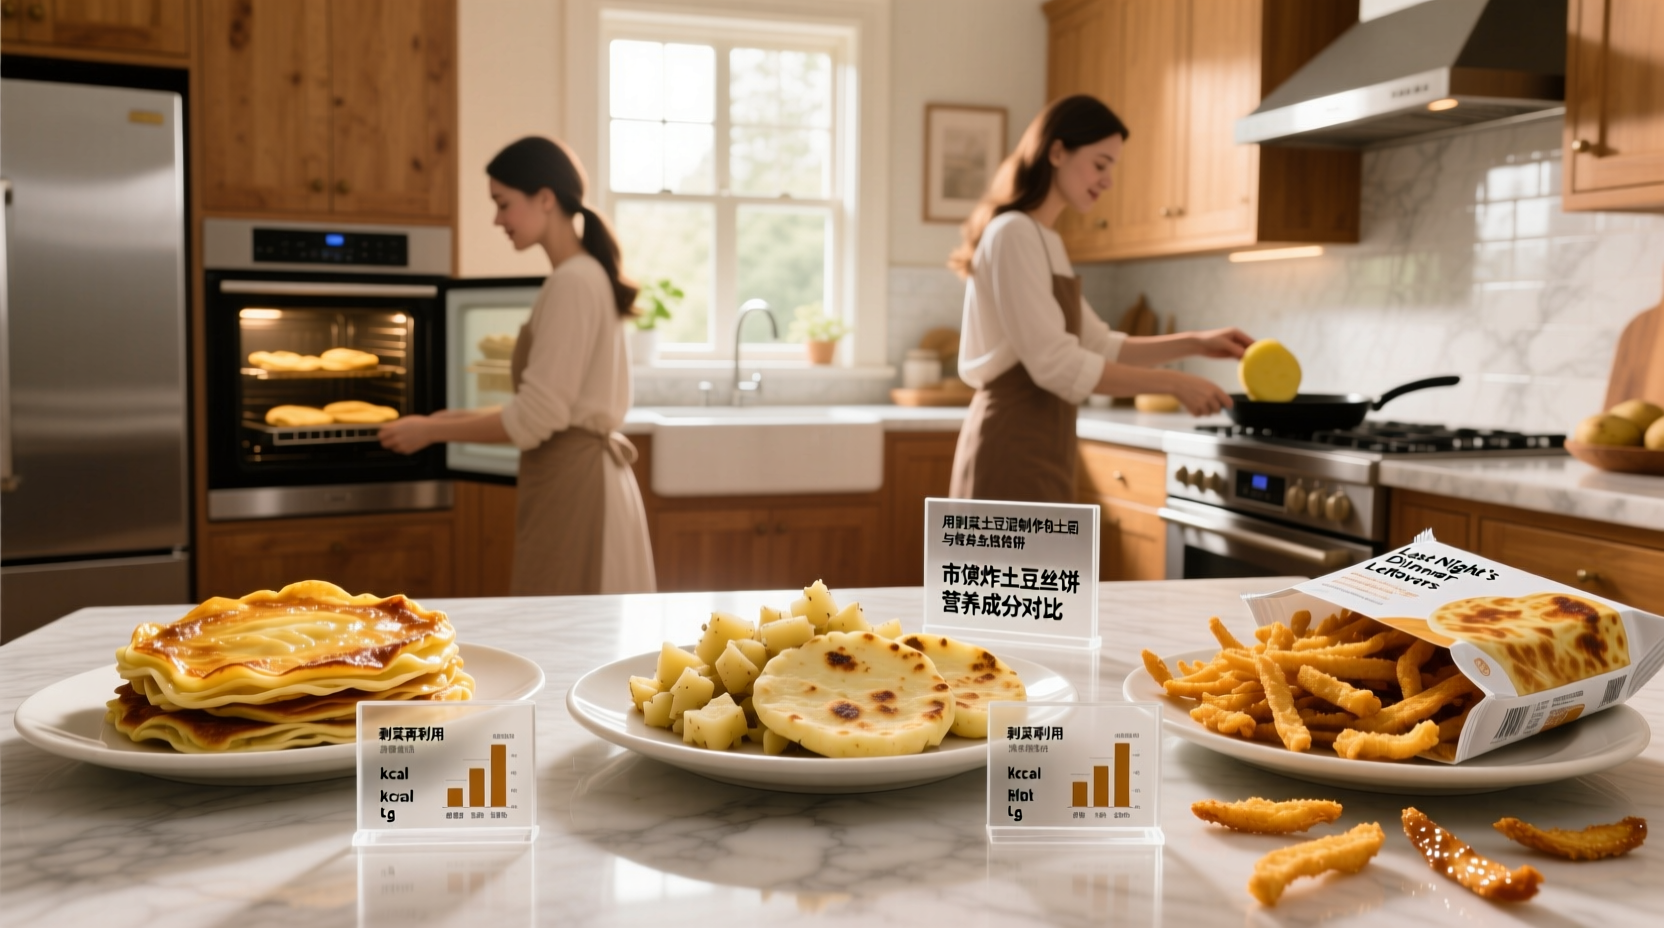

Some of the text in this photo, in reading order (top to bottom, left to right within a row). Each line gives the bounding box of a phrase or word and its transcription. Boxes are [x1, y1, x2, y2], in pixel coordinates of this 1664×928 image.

[942, 590, 1063, 620] 营养成分对比
[380, 767, 409, 780] kcal
